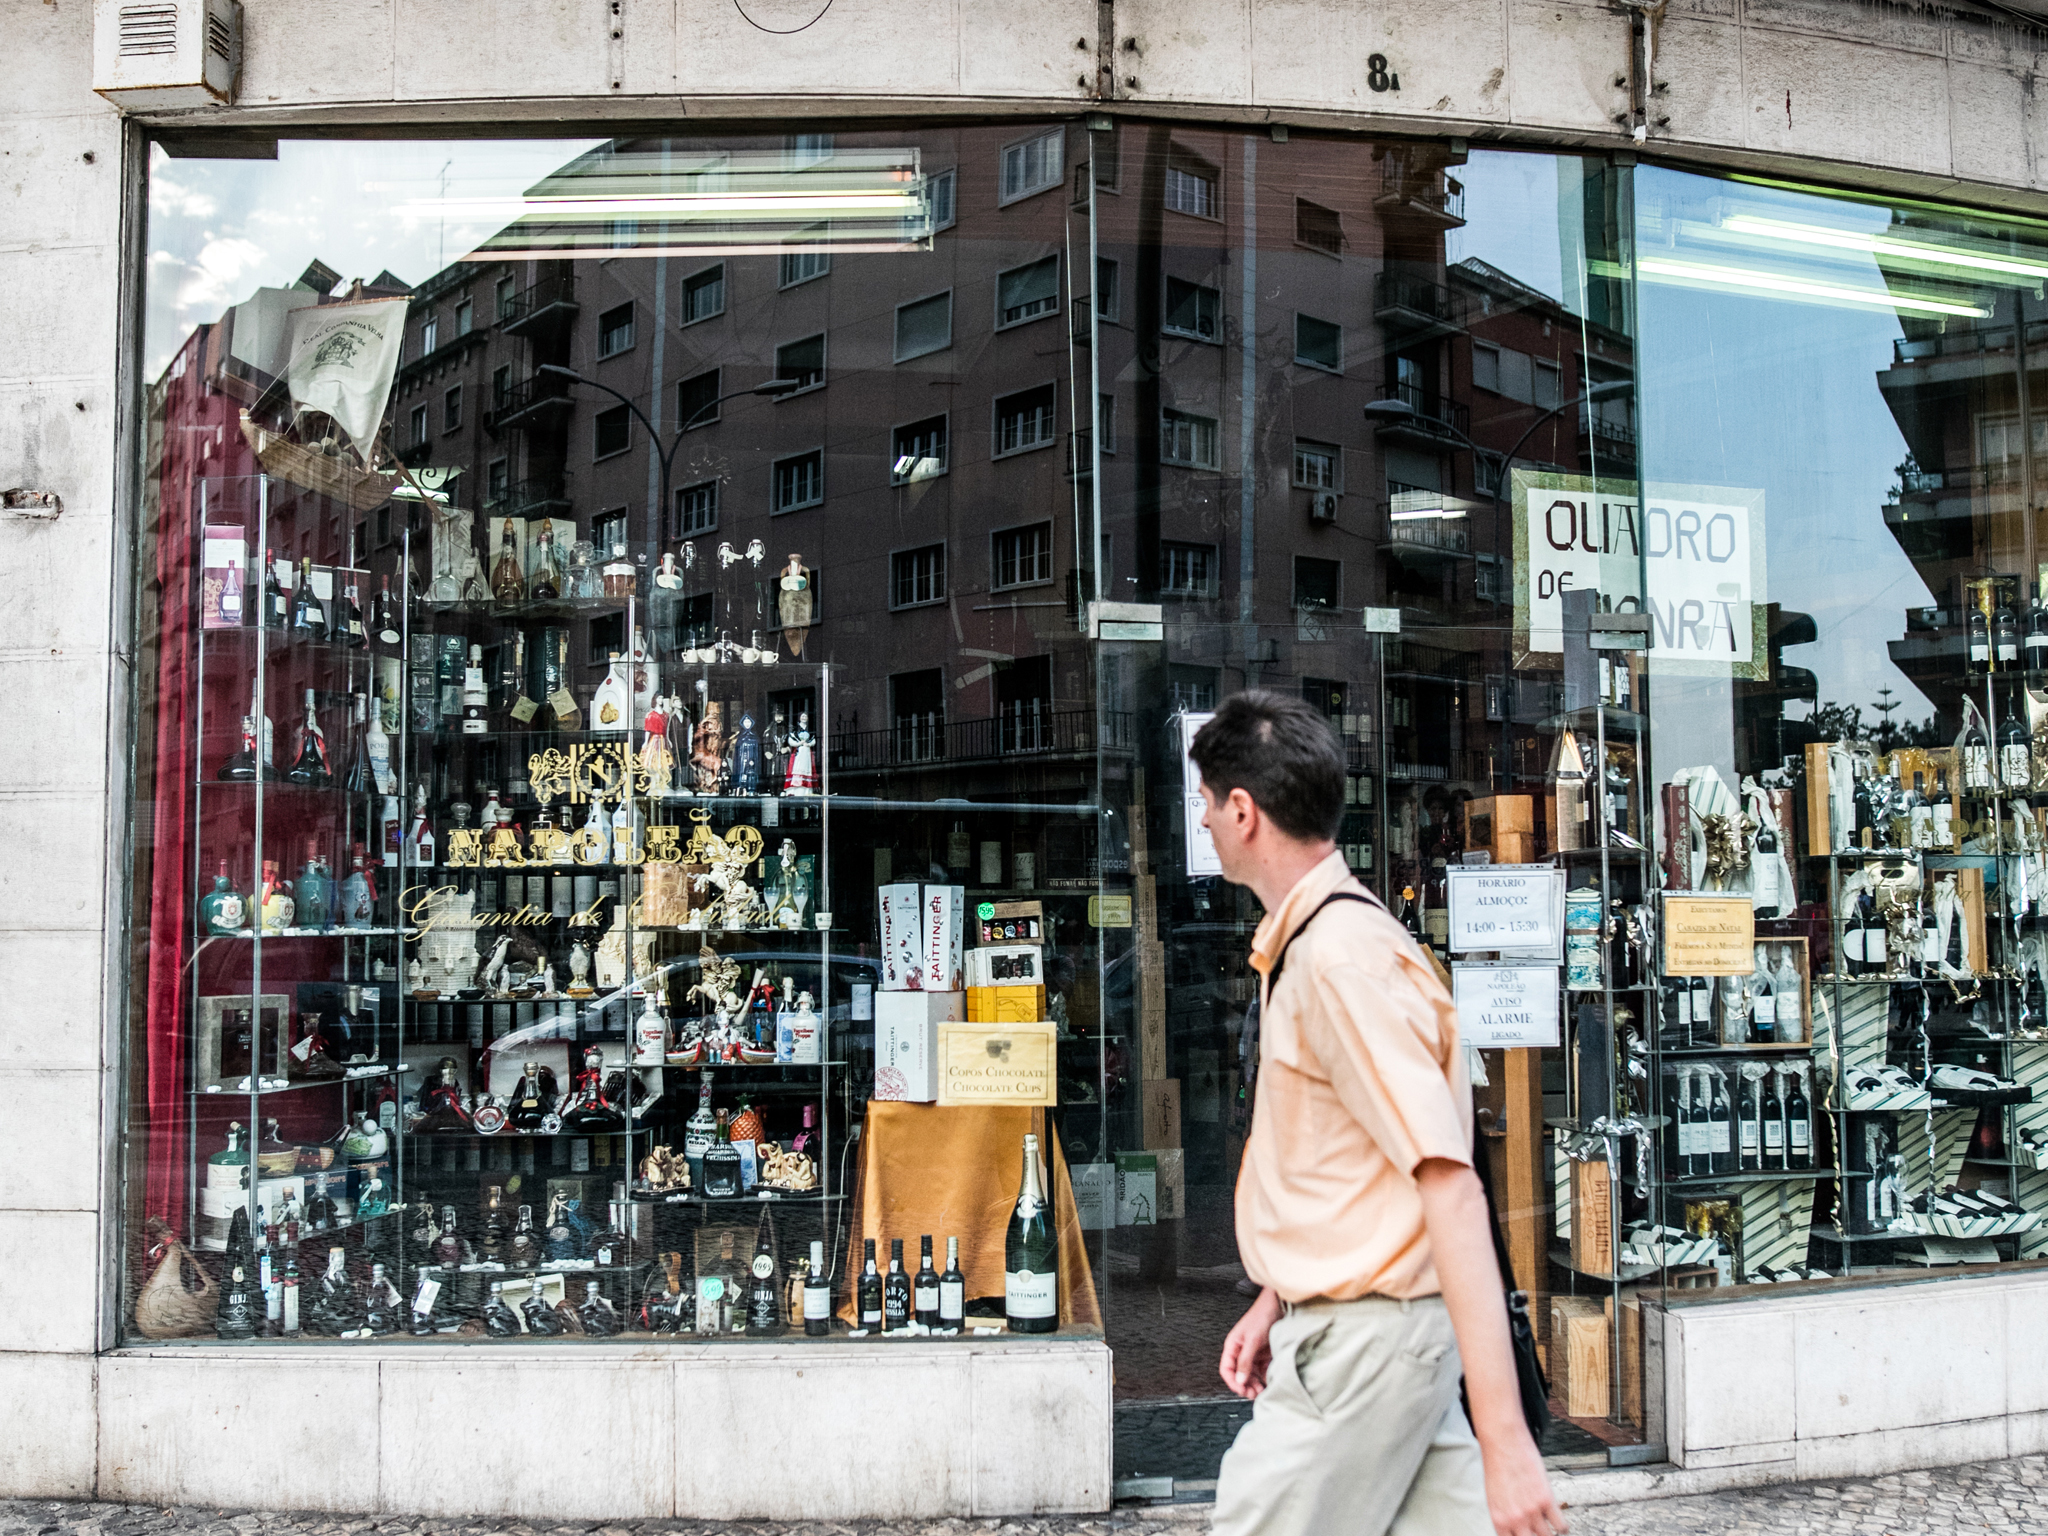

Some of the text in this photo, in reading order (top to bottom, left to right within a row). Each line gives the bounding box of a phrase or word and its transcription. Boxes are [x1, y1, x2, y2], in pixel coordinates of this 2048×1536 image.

[368, 324, 384, 341] VELHA
[1545, 500, 1736, 563] QUADRO
[1538, 569, 1573, 600] DE
[447, 807, 764, 868] NAPOLEÃO
[1478, 876, 1526, 888] HORÁRIO
[1476, 896, 1528, 907] ALMOÇO:
[399, 884, 556, 943] Garantia
[566, 895, 608, 929] de
[1466, 922, 1496, 933] 14:00
[1510, 920, 1539, 932] 15:30
[932, 896, 942, 981] TAITTINGER
[1491, 998, 1522, 1006] AVISO
[1478, 1013, 1534, 1024] ALARME
[949, 1066, 1046, 1078] COPOS CHOCOLATE
[952, 1082, 1042, 1094] CHOCOLATE CUPS
[230, 1294, 248, 1304] GINJ
[886, 1286, 908, 1301] ORTO
[1008, 1290, 1048, 1298] TAITTINGER
